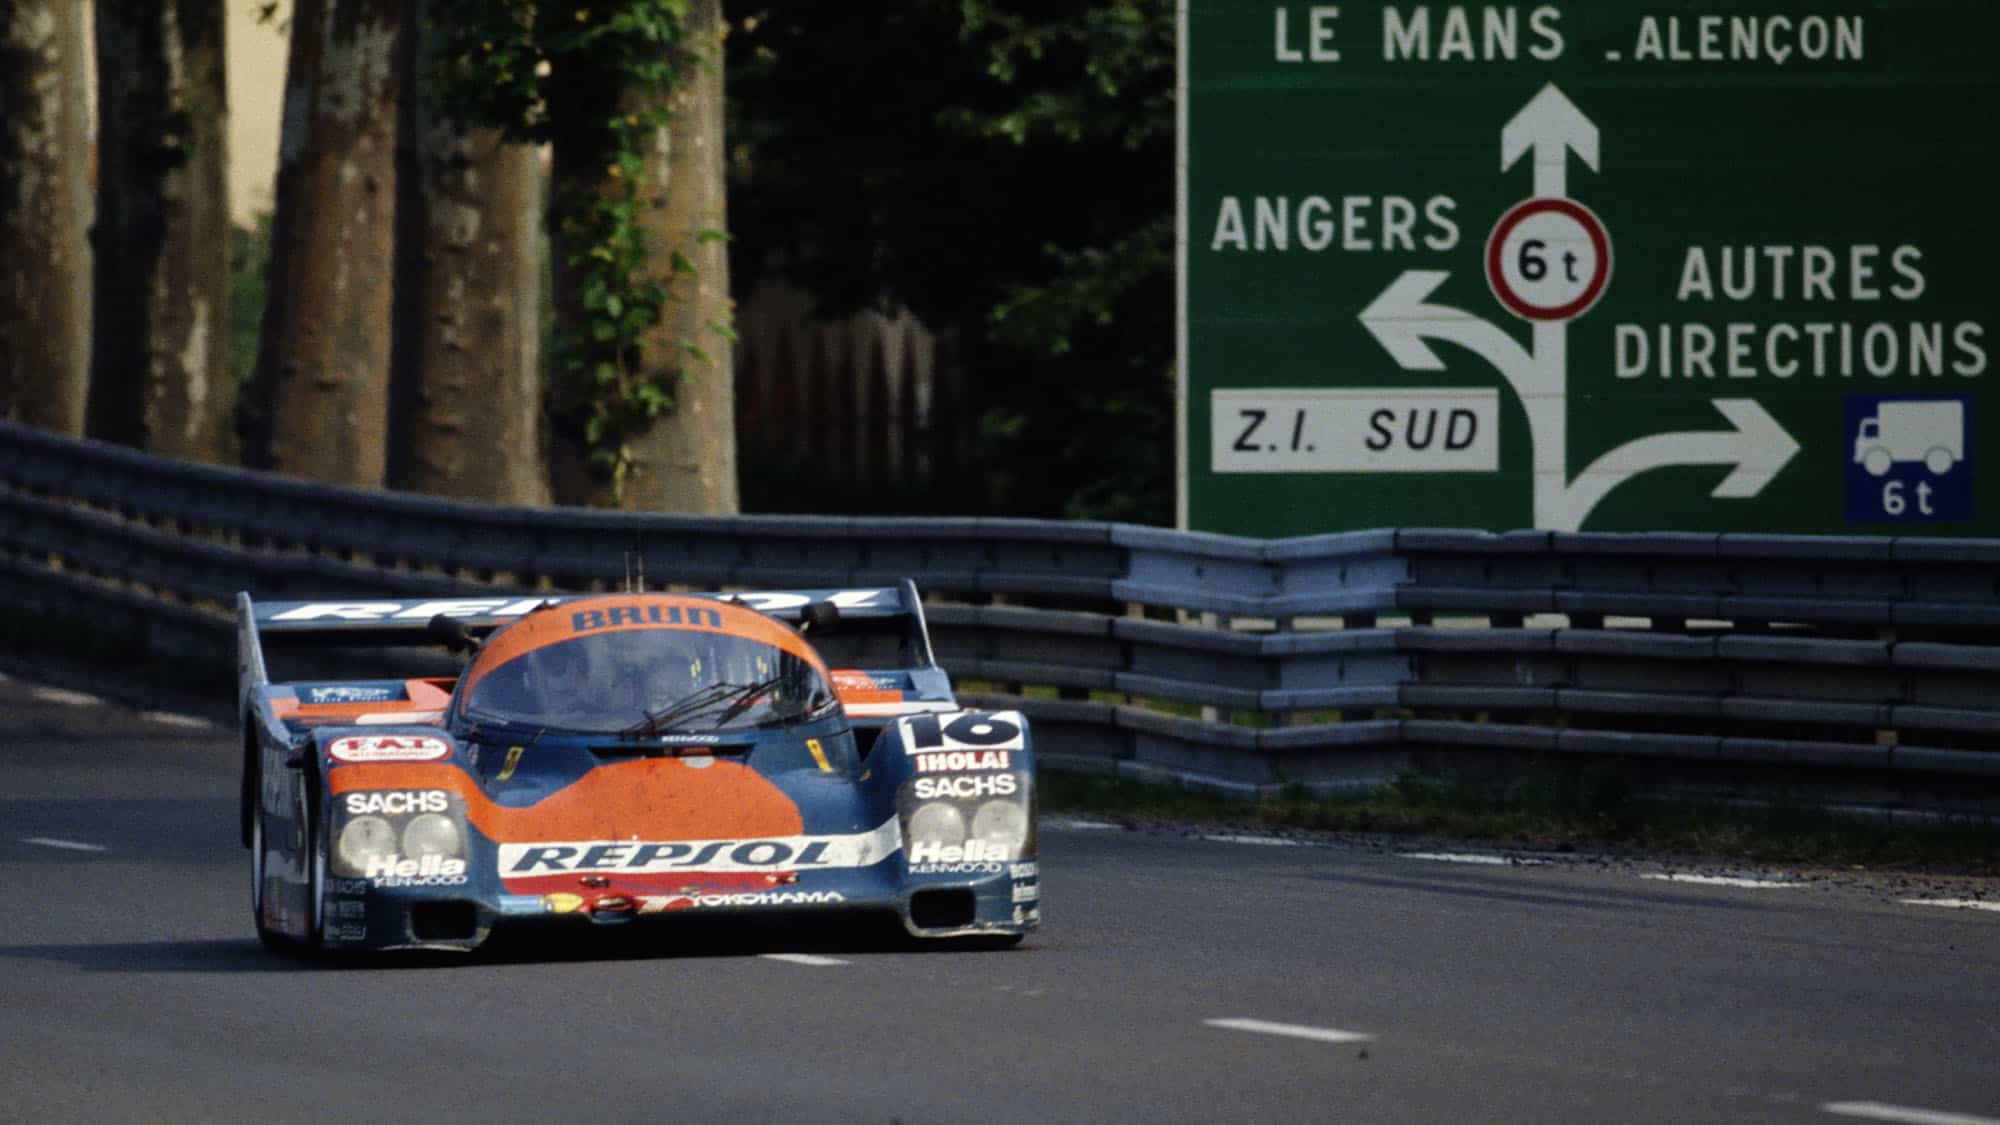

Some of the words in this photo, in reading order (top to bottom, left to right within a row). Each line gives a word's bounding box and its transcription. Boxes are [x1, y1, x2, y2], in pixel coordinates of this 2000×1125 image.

[1275, 6, 1340, 62] LE
[1383, 6, 1564, 61] MANS
[1635, 15, 1863, 65] ALENÇON
[1211, 195, 1460, 251] ANGERS
[1518, 239, 1548, 282] 6
[1677, 245, 1925, 301] AUTRES
[1615, 321, 1987, 379] DIRECTIONS
[1232, 409, 1316, 452] Z.I.
[1364, 408, 1478, 452] SUD
[1882, 480, 1906, 515] 6
[572, 605, 722, 632] BRUN
[904, 713, 1020, 748] 16
[914, 773, 1017, 799] SACHS
[346, 790, 449, 815] SACHS
[365, 854, 466, 877] Hella
[511, 841, 830, 871] REPSOL
[910, 839, 1009, 863] Hella
[371, 874, 468, 888] KENWOOD
[690, 890, 845, 907] YOKOHAMA
